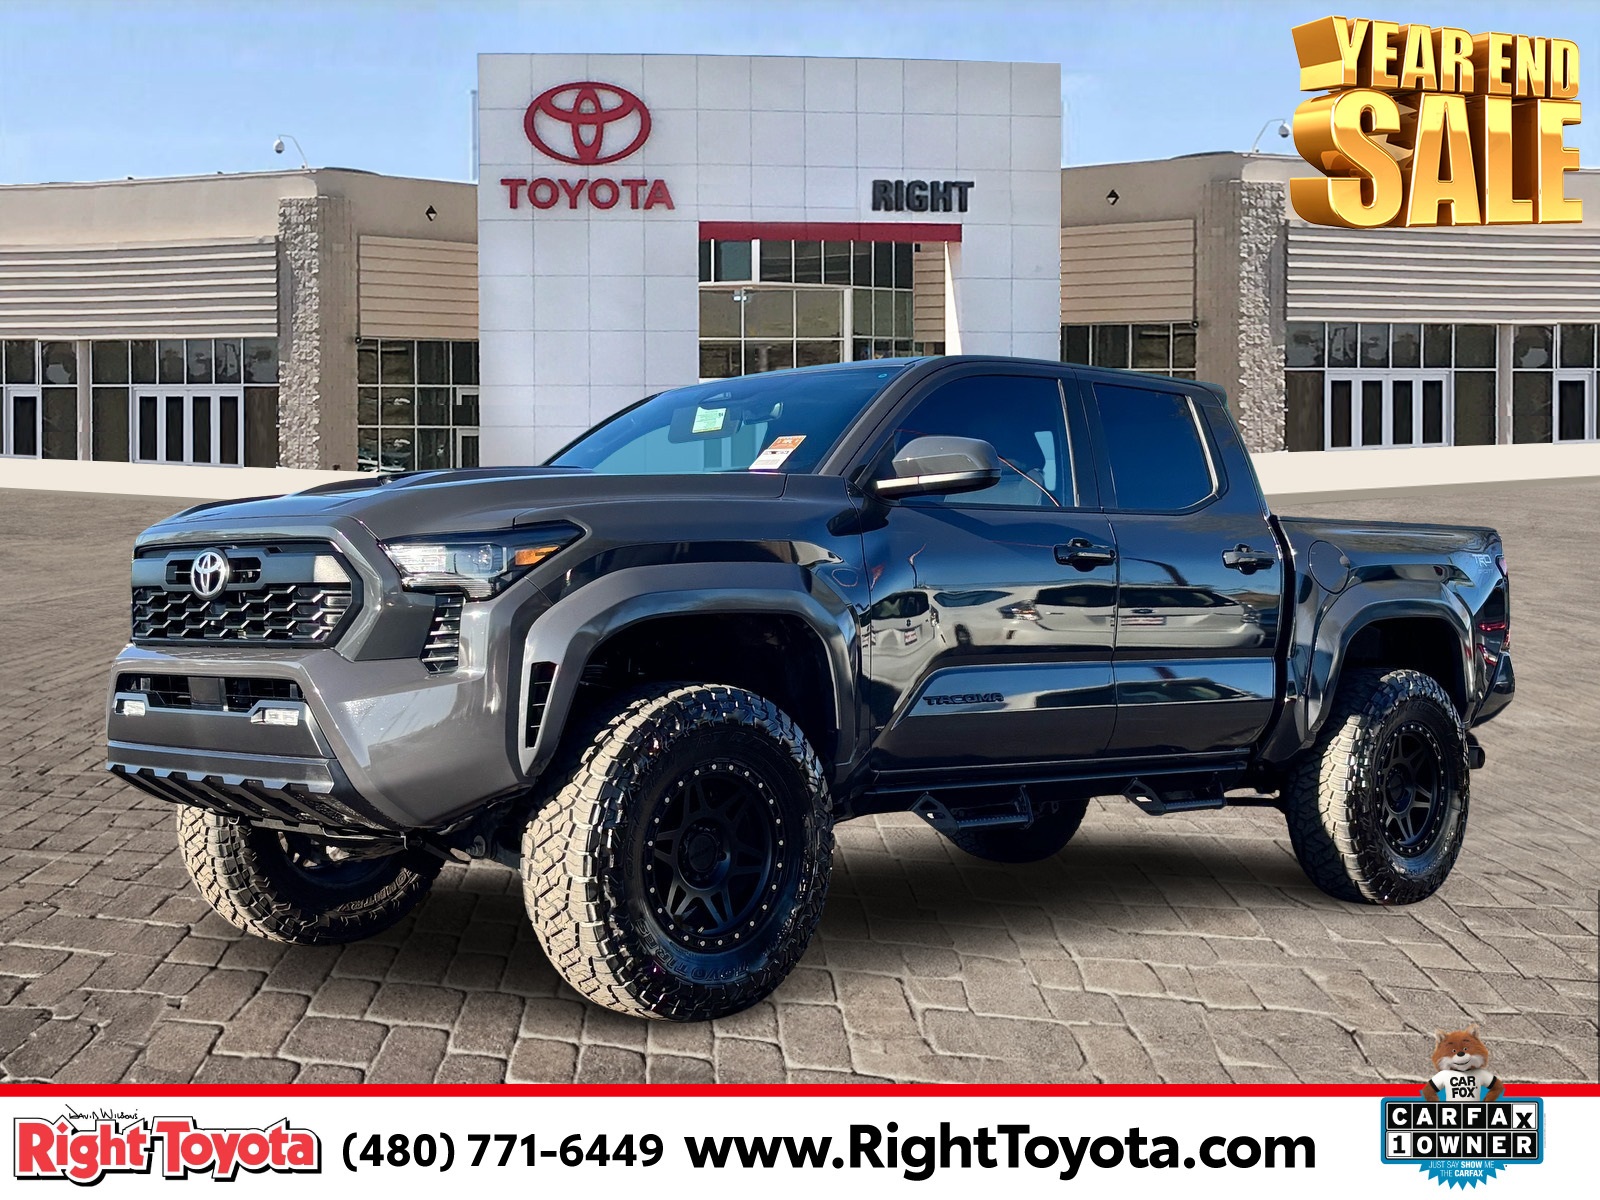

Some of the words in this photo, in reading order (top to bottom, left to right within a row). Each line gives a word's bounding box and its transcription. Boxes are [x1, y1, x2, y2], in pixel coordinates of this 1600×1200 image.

[500, 178, 675, 210] TOYOTA
[871, 179, 974, 213] RIGHT
[1471, 553, 1492, 567] TRD
[923, 692, 1004, 706] TACOMA
